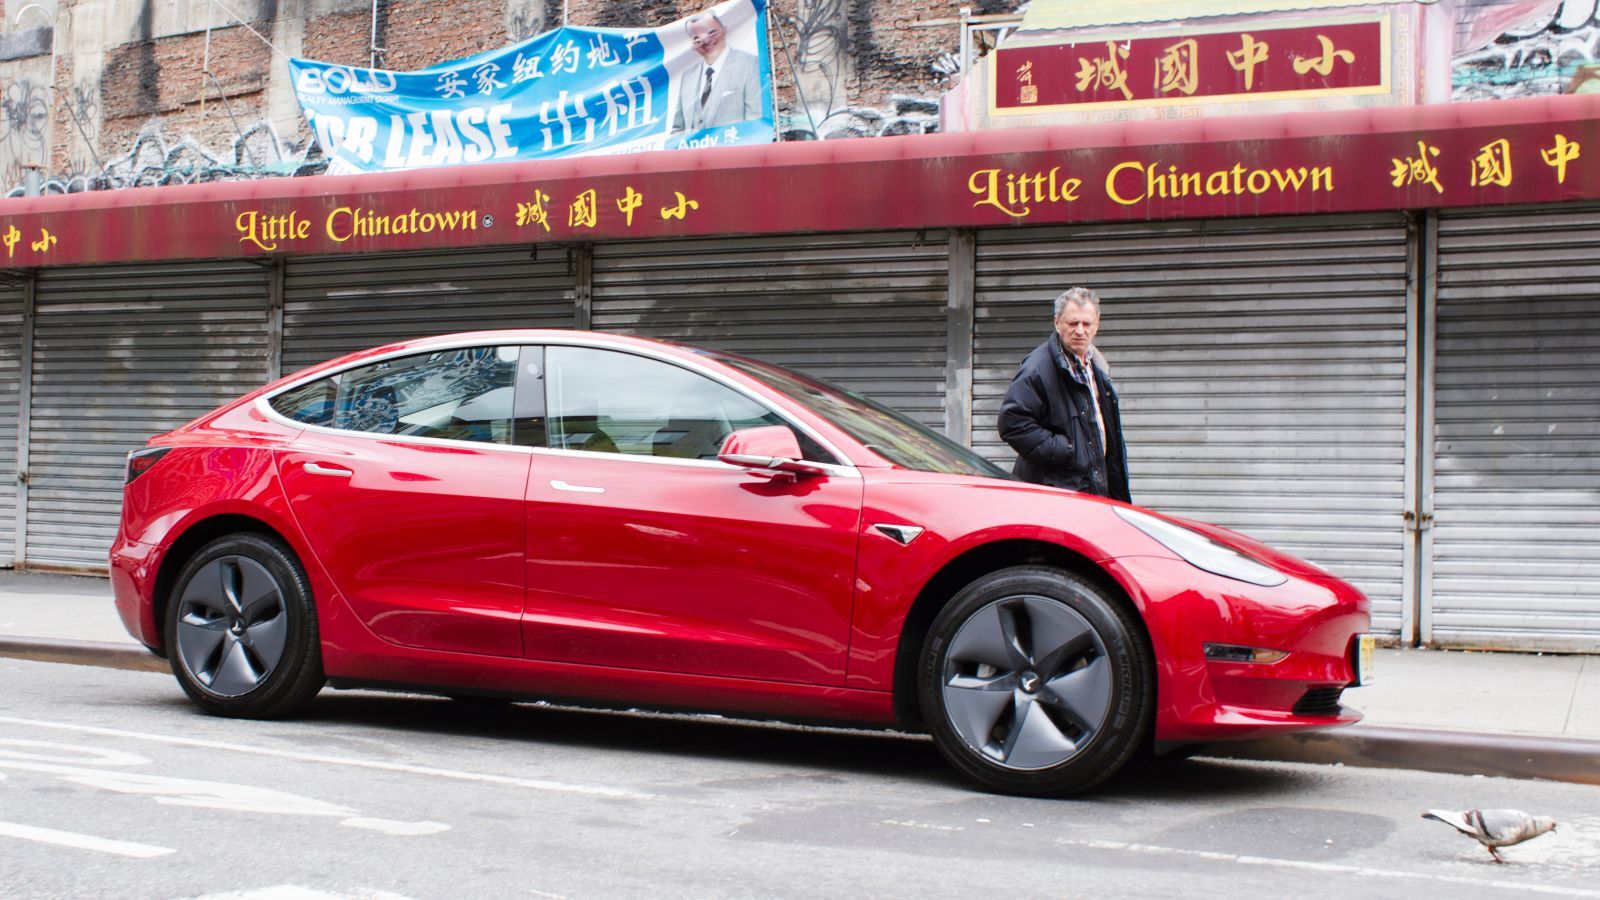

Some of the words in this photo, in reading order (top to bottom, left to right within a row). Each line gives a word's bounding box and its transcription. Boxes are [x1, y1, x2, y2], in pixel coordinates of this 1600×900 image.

[297, 66, 397, 94] BOLD
[383, 103, 519, 168] LEASE
[538, 76, 658, 151] 出租
[678, 134, 719, 151] Andy
[968, 166, 1082, 217] Little
[1105, 160, 1335, 206] Chinatown
[236, 209, 312, 251] Little
[326, 206, 477, 242] Chinatown
